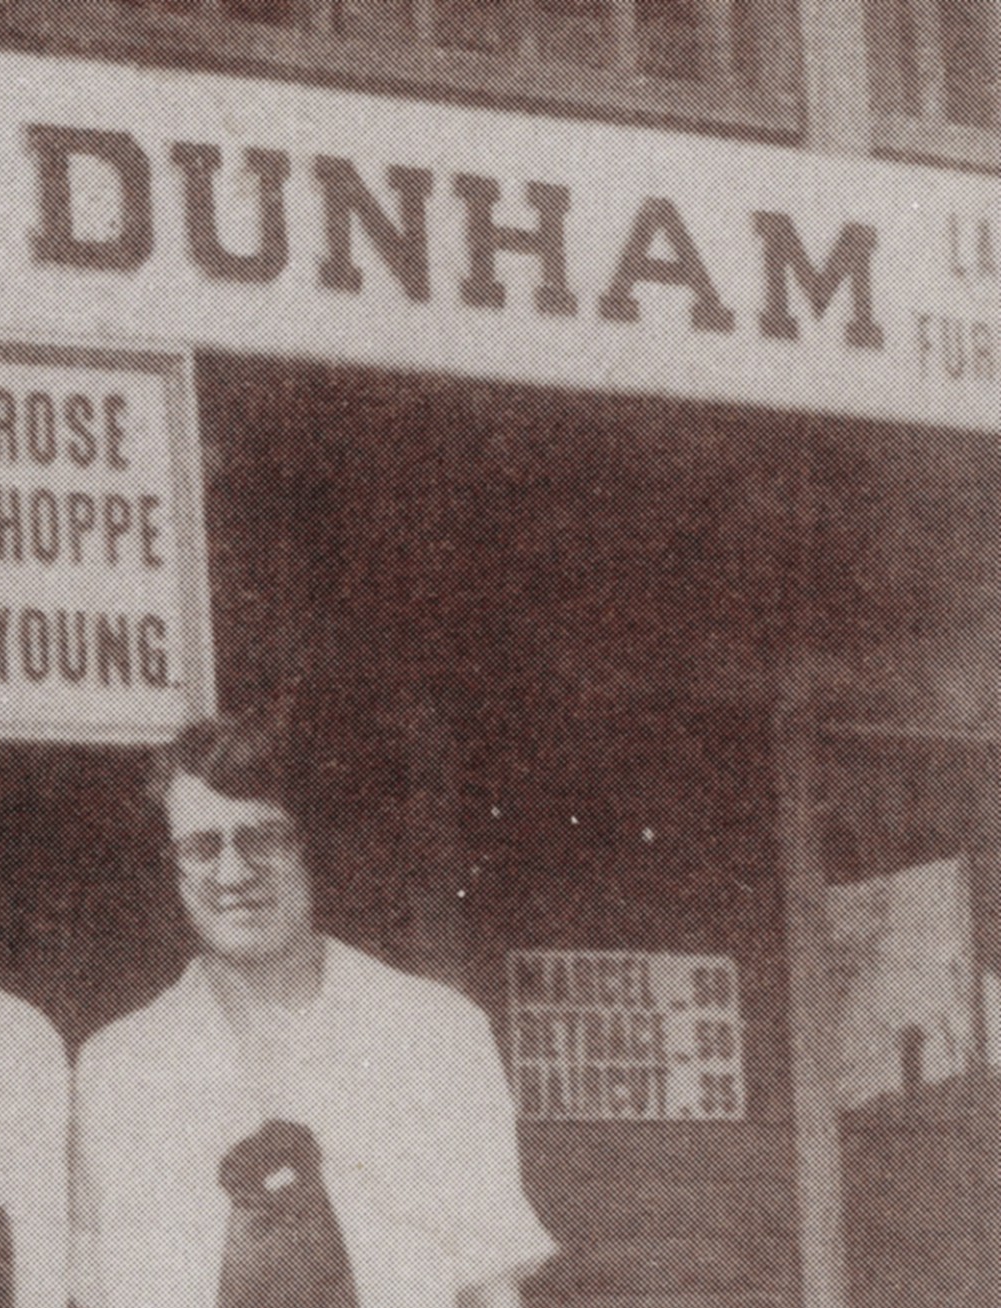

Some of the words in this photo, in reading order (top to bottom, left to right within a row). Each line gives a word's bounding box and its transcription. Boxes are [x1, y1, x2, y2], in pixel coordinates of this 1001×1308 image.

[22, 121, 885, 350] DUNHAM
[516, 957, 656, 1007] MARCEL
[519, 1011, 668, 1062] RETRACE
[520, 1065, 669, 1115] HAIRCUT
